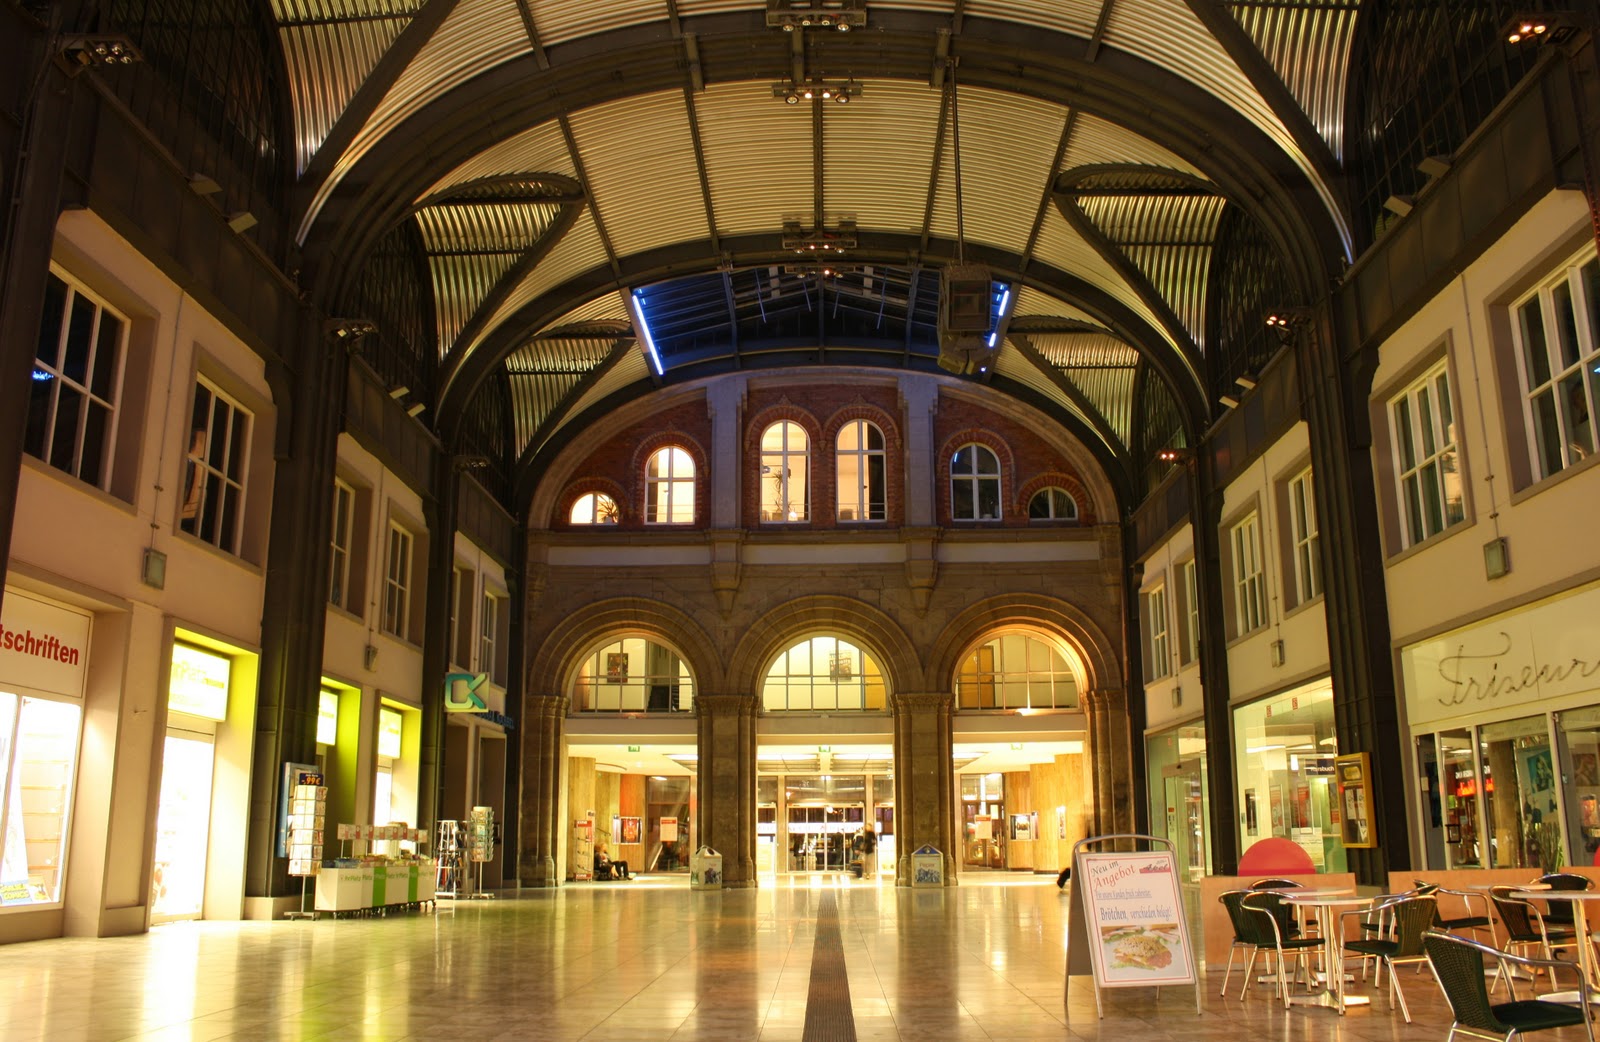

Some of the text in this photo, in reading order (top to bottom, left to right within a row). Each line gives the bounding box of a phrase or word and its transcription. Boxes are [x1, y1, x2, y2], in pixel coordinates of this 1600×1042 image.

[1091, 860, 1119, 877] Neu im
[1095, 864, 1136, 891] Angebot
